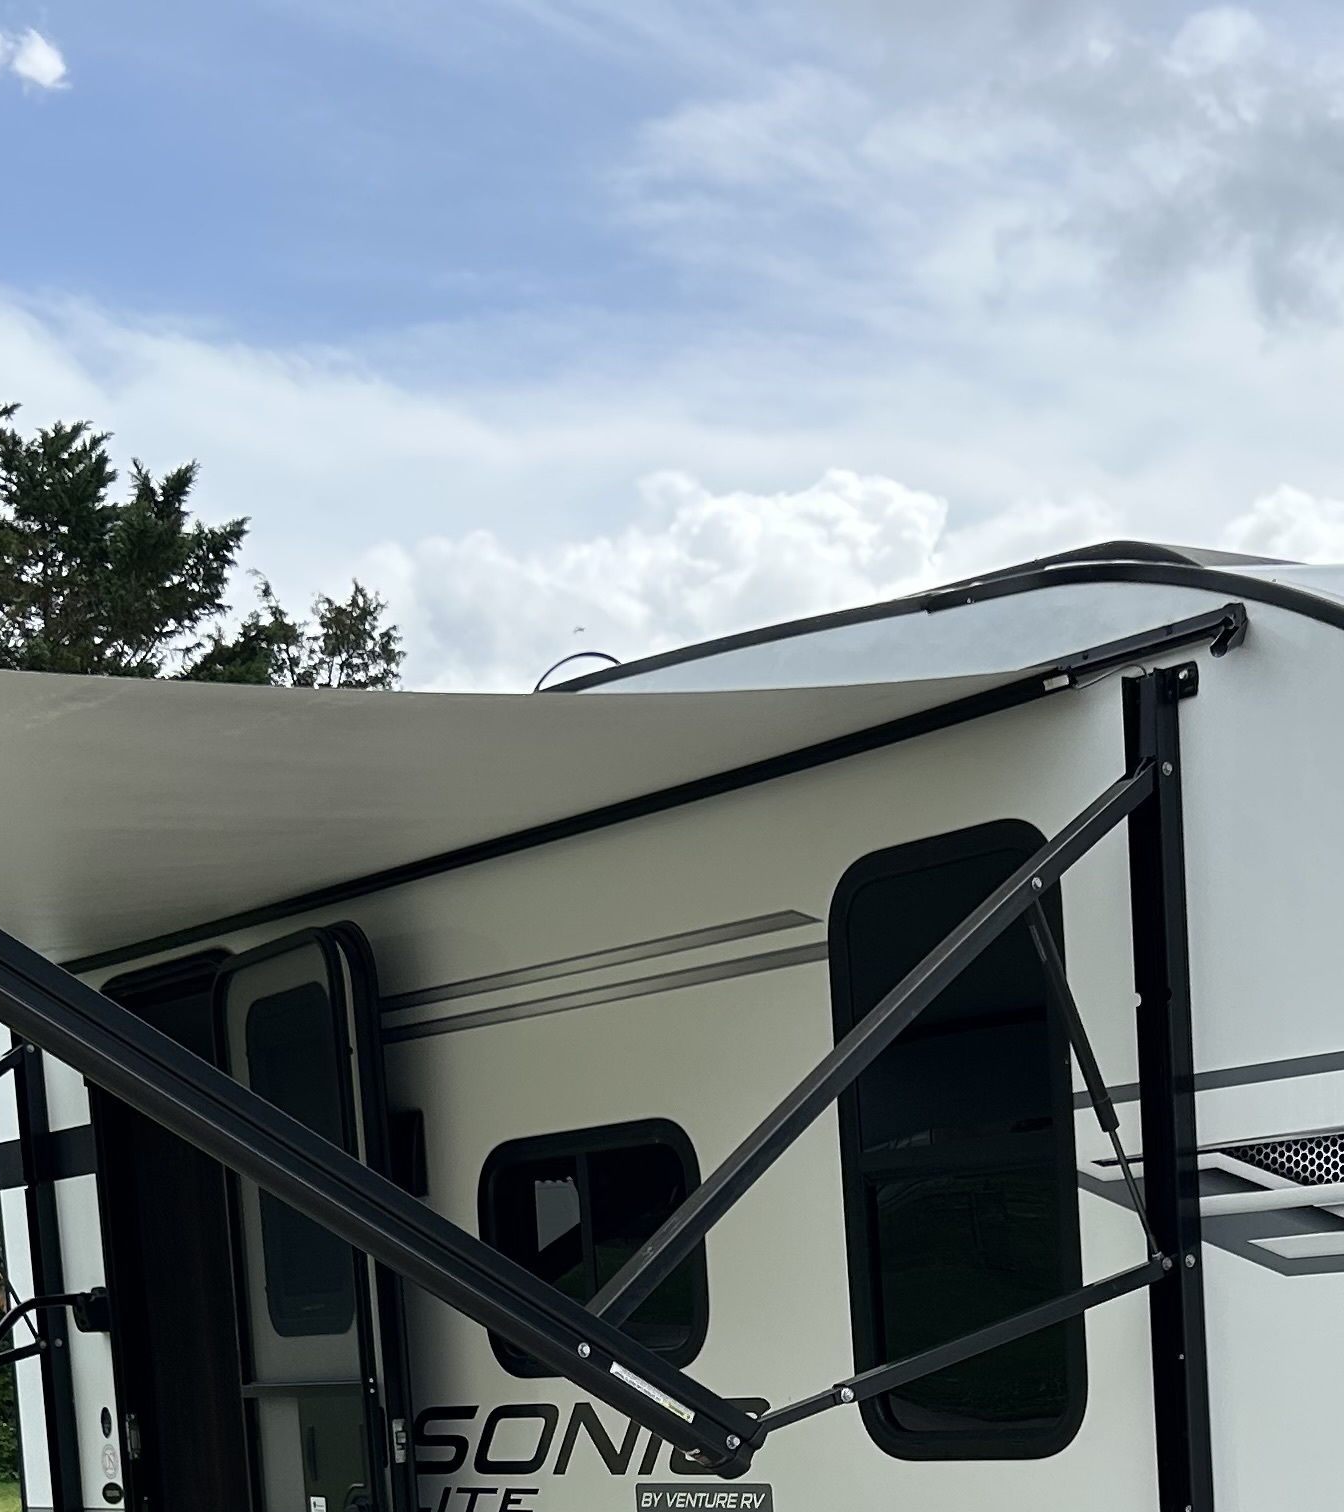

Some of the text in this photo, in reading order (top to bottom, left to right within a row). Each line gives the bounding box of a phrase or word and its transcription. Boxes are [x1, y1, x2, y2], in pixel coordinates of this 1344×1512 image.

[641, 1492, 766, 1509] BY VENTURE RV
